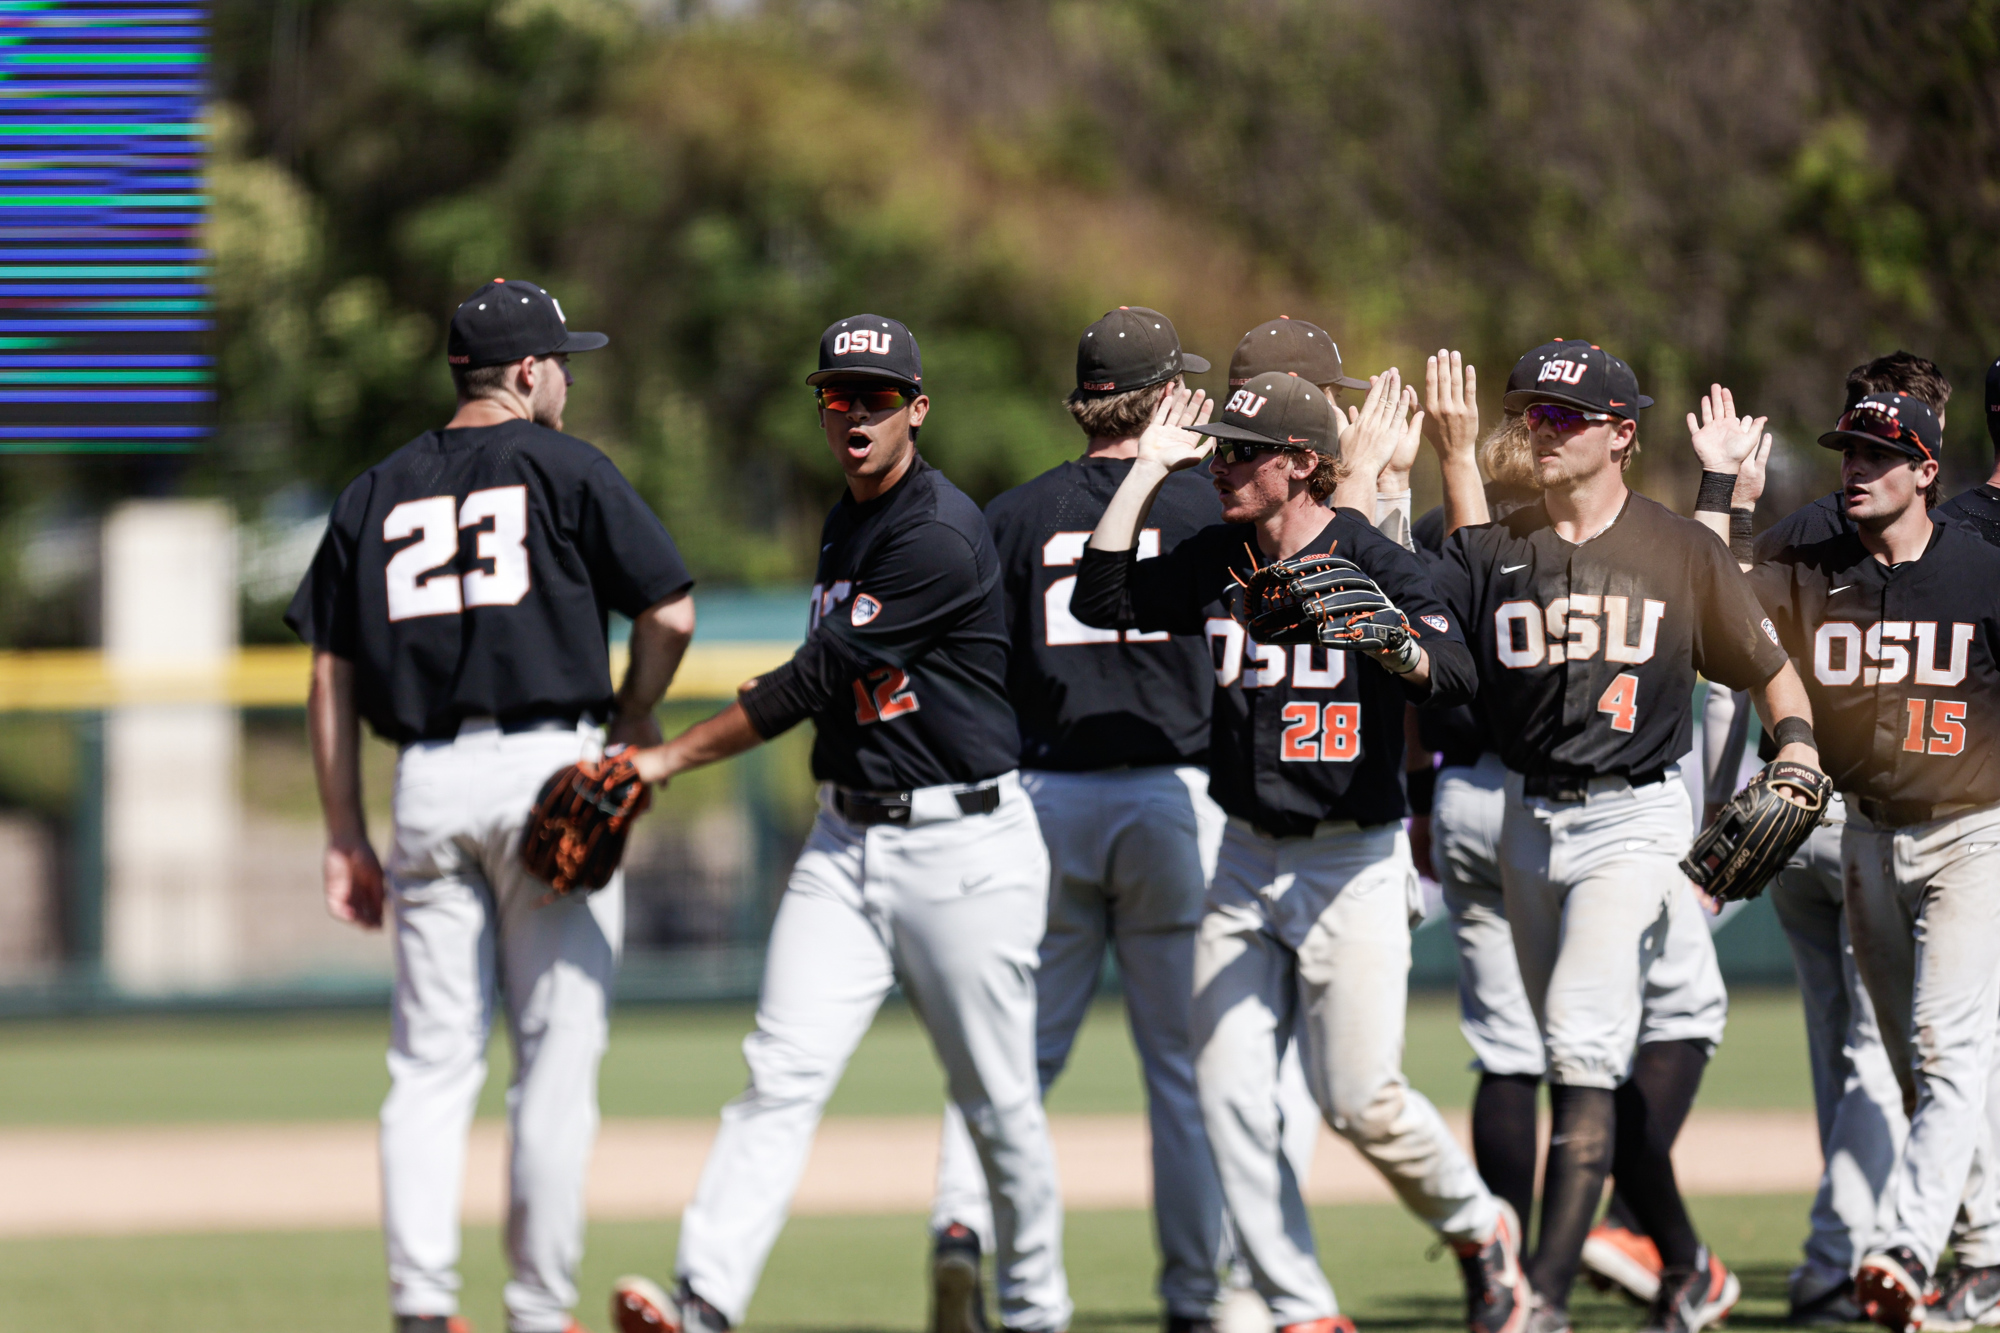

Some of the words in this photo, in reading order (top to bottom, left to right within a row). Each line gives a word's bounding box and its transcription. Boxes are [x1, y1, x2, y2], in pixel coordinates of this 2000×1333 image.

[833, 329, 892, 357] OSU
[1537, 359, 1588, 385] OSU
[383, 484, 531, 623] 23
[1494, 592, 1666, 669] OSU
[1813, 620, 1976, 687] OSU
[852, 663, 920, 726] 12
[1597, 672, 1639, 733] 4
[1280, 701, 1361, 762] 28
[1902, 697, 1968, 757] 15
[1780, 766, 1816, 785] Wilson
